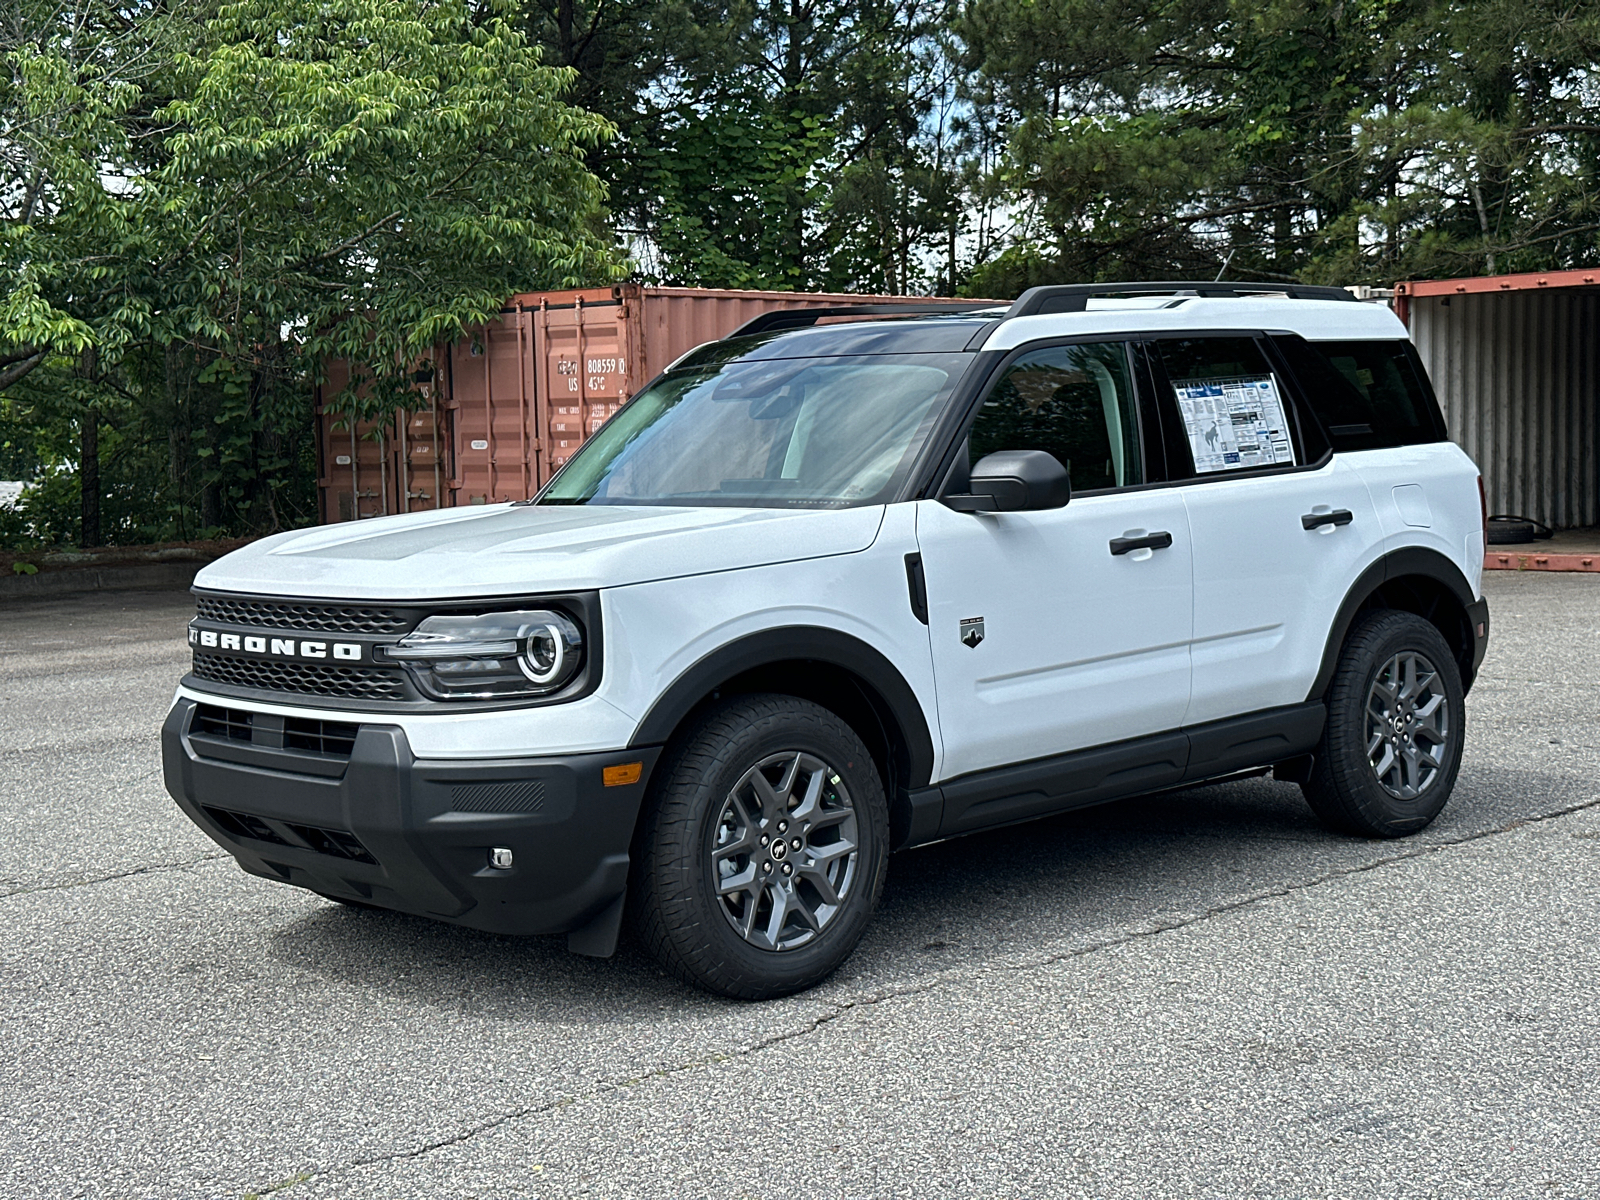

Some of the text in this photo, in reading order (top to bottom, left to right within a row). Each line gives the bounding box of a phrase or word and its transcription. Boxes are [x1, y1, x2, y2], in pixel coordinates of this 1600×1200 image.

[587, 358, 616, 373] 808559
[568, 377, 578, 392] US
[200, 630, 362, 661] BRONCO
